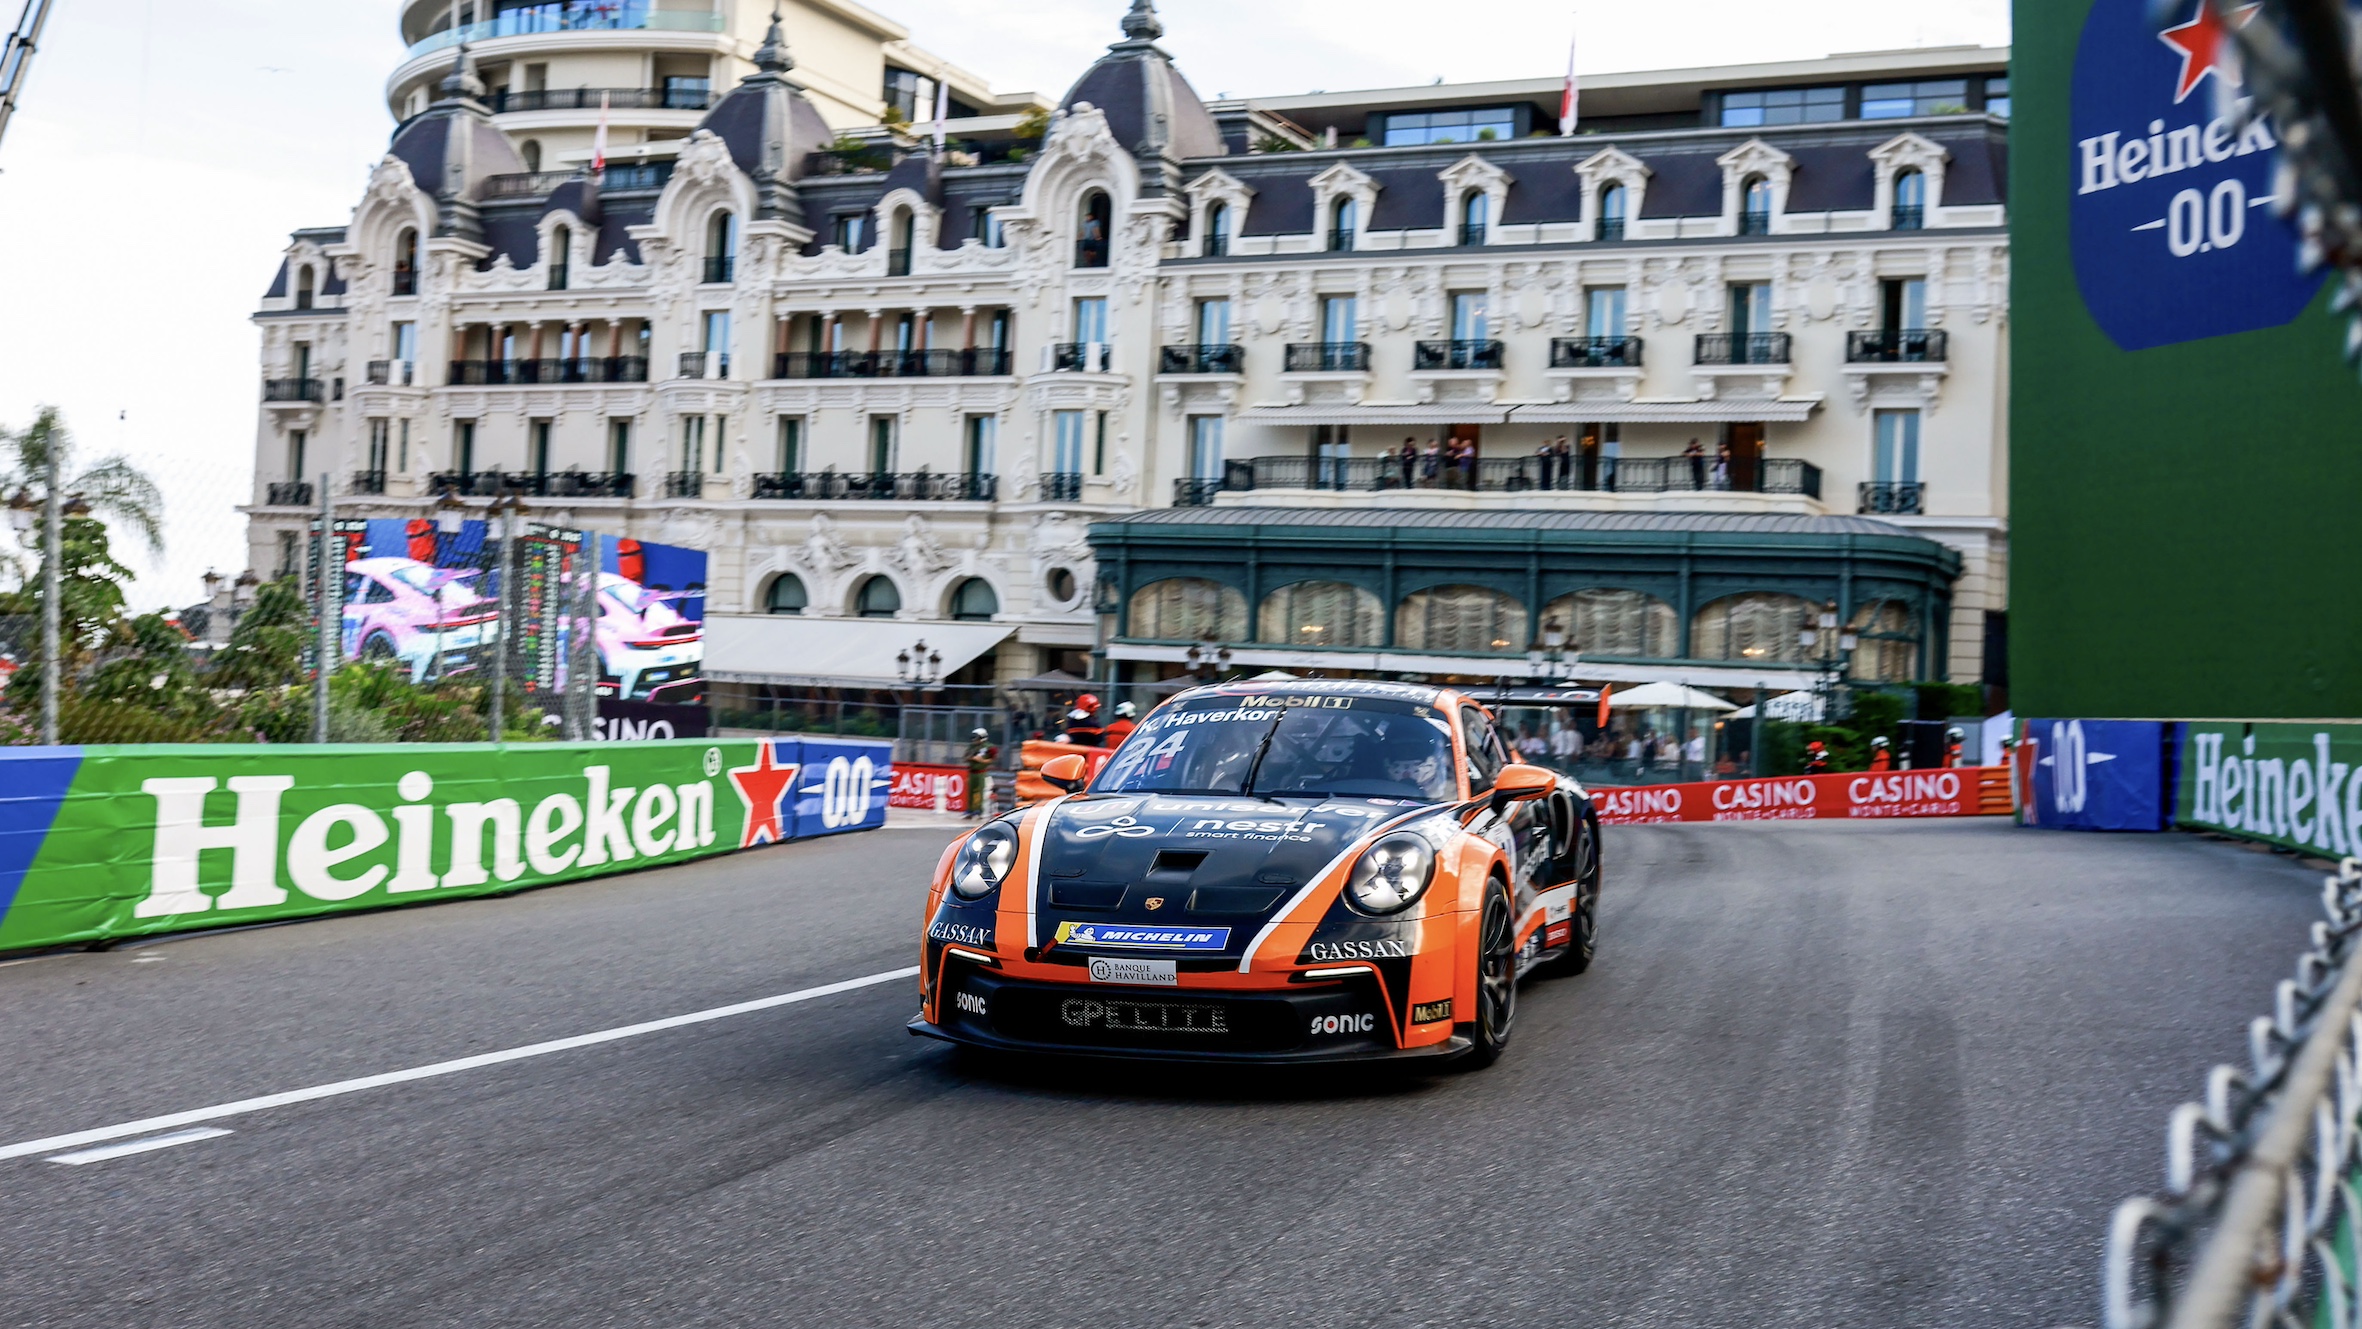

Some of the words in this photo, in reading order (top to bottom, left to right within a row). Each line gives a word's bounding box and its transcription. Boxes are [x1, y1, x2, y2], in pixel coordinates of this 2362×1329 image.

[2168, 179, 2246, 257] 0.0
[1239, 695, 1322, 708] Mobil
[1138, 718, 1159, 735] K.
[1115, 730, 1190, 771] 24
[821, 755, 873, 829] 0.0
[888, 771, 964, 798] ASIO
[1712, 780, 1816, 810] CASINO
[1848, 772, 1960, 804] CASINO
[1185, 831, 1238, 839] smart
[1243, 833, 1312, 842] finance
[1193, 819, 1326, 833] nestr
[134, 764, 717, 918] Heineken
[930, 922, 991, 946] GASSAN
[1101, 930, 1213, 943] MICHELIN
[1310, 940, 1405, 961] GASSAN
[1114, 963, 1151, 973] BANQUE
[1115, 972, 1175, 982] HAVILLAND
